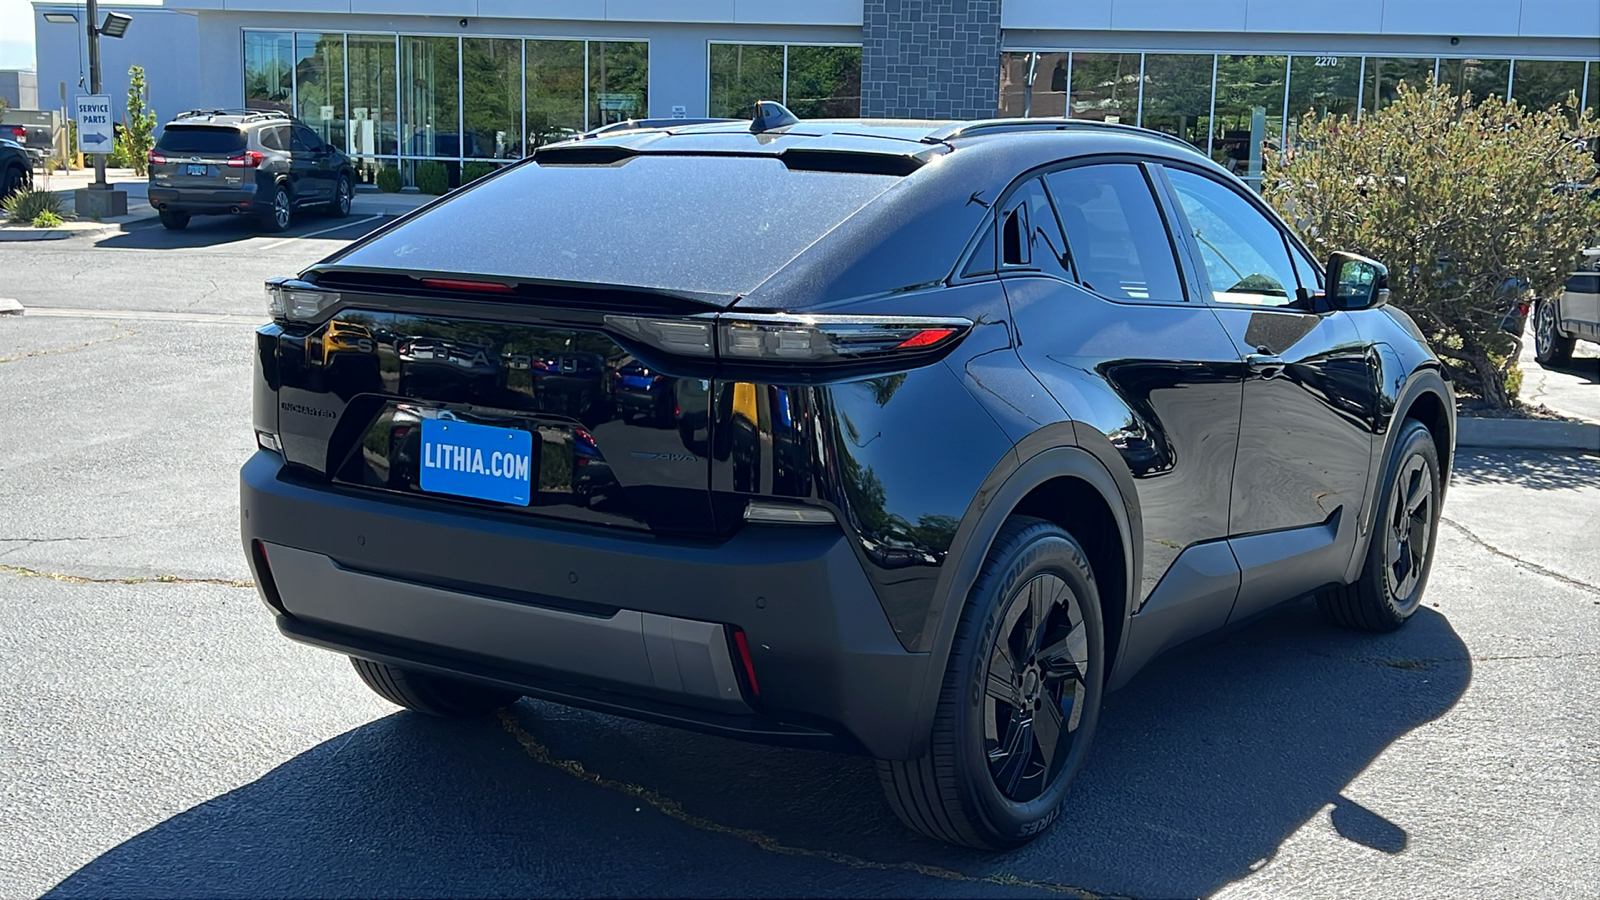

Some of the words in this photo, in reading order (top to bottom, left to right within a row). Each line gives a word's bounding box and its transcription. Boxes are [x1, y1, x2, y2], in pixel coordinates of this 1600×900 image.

[1315, 56, 1338, 66] 2270
[79, 104, 108, 113] SERVICE
[83, 115, 106, 124] PARTS
[357, 338, 578, 374] SUBARU
[281, 402, 337, 419] UNCHARTED
[425, 443, 529, 482] LITHIA.COM
[1017, 803, 1060, 837] TIRES
